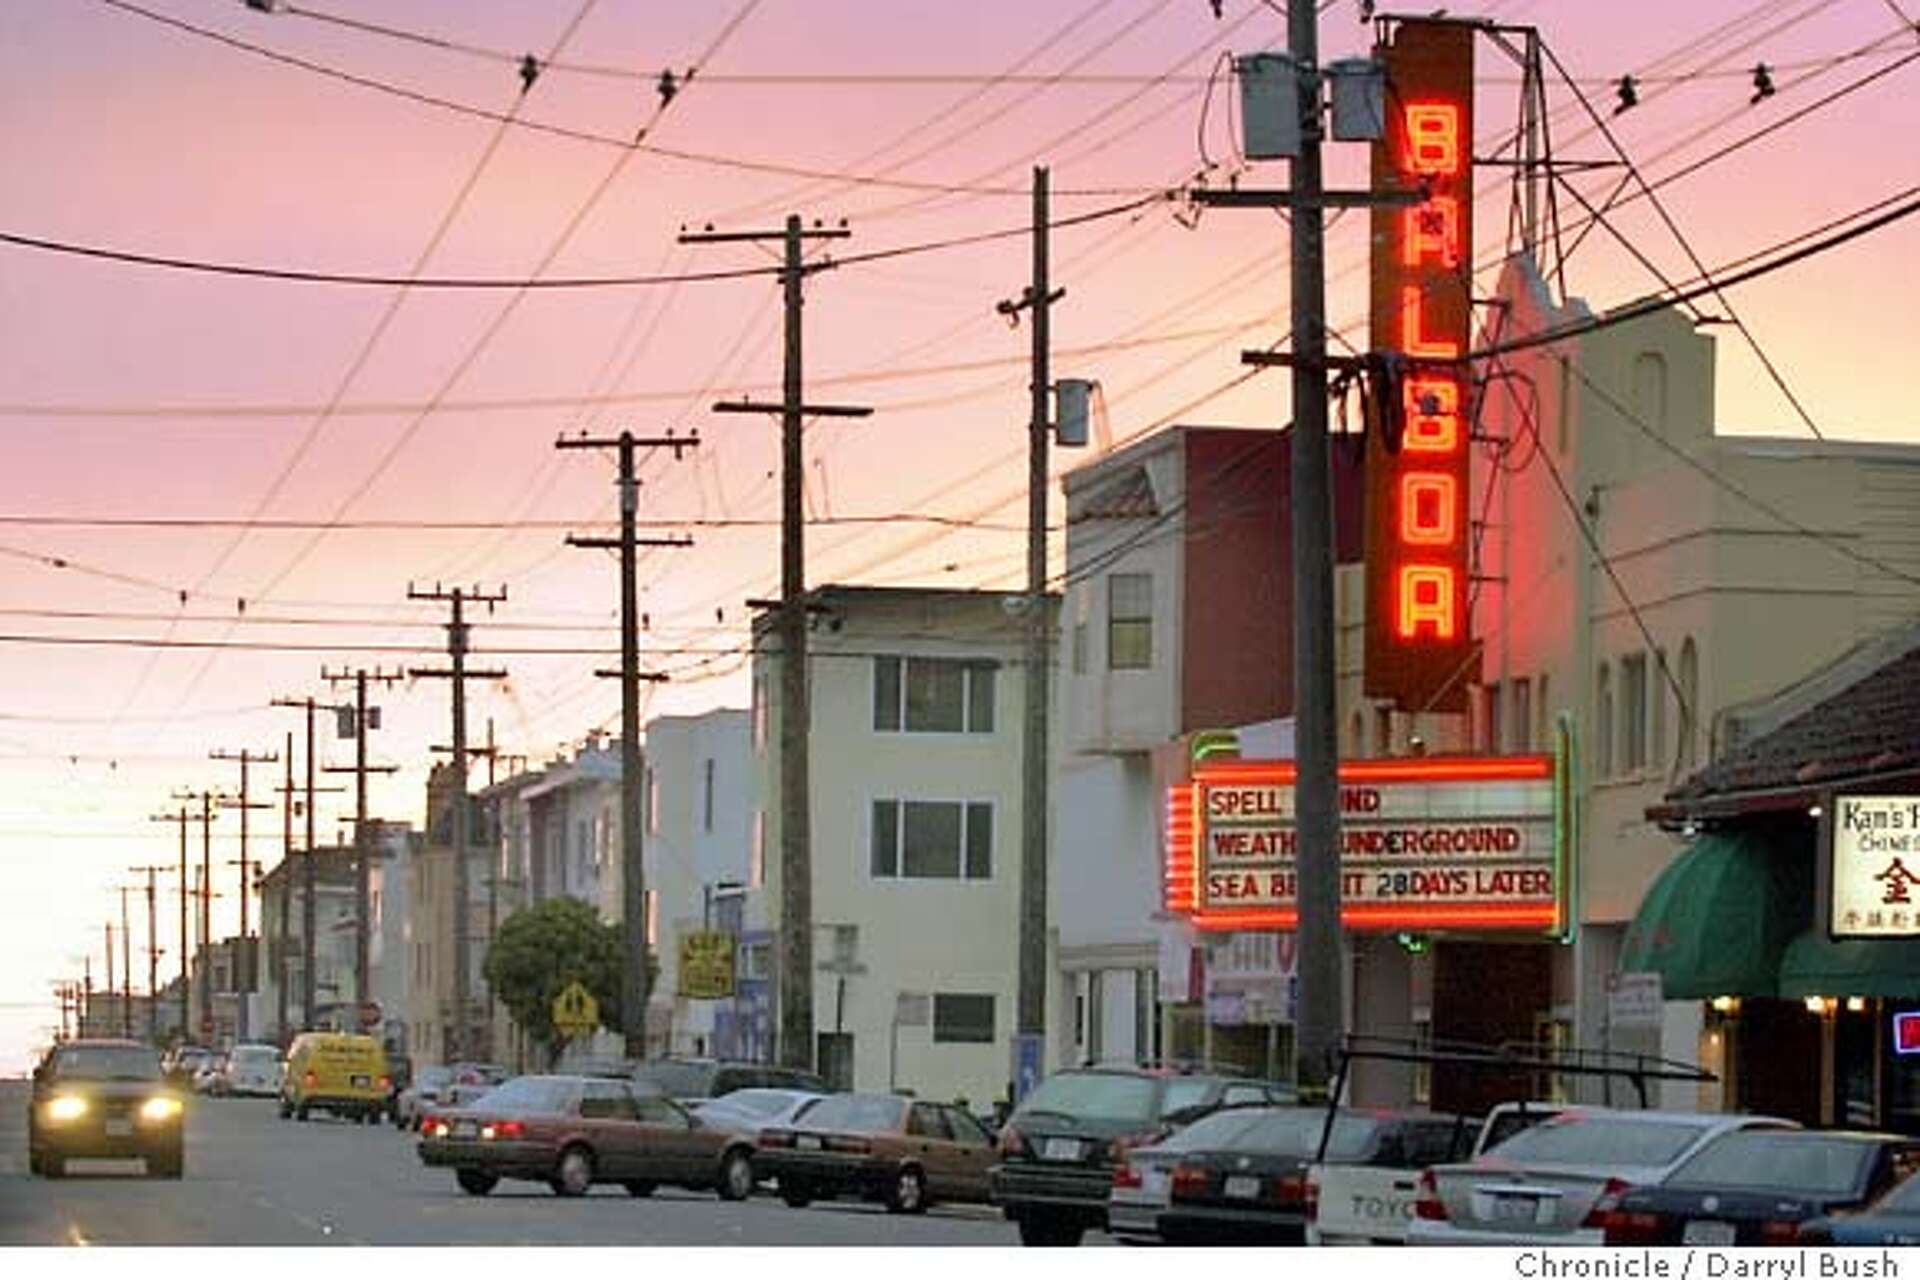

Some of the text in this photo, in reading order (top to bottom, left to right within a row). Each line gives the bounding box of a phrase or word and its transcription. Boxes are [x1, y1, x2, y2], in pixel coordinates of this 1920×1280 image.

[1401, 103, 1459, 638] BALBOA
[1210, 790, 1282, 815] SPELL
[1214, 832, 1297, 855] WEATH
[1209, 873, 1259, 898] SEA
[1475, 867, 1553, 895] LATER
